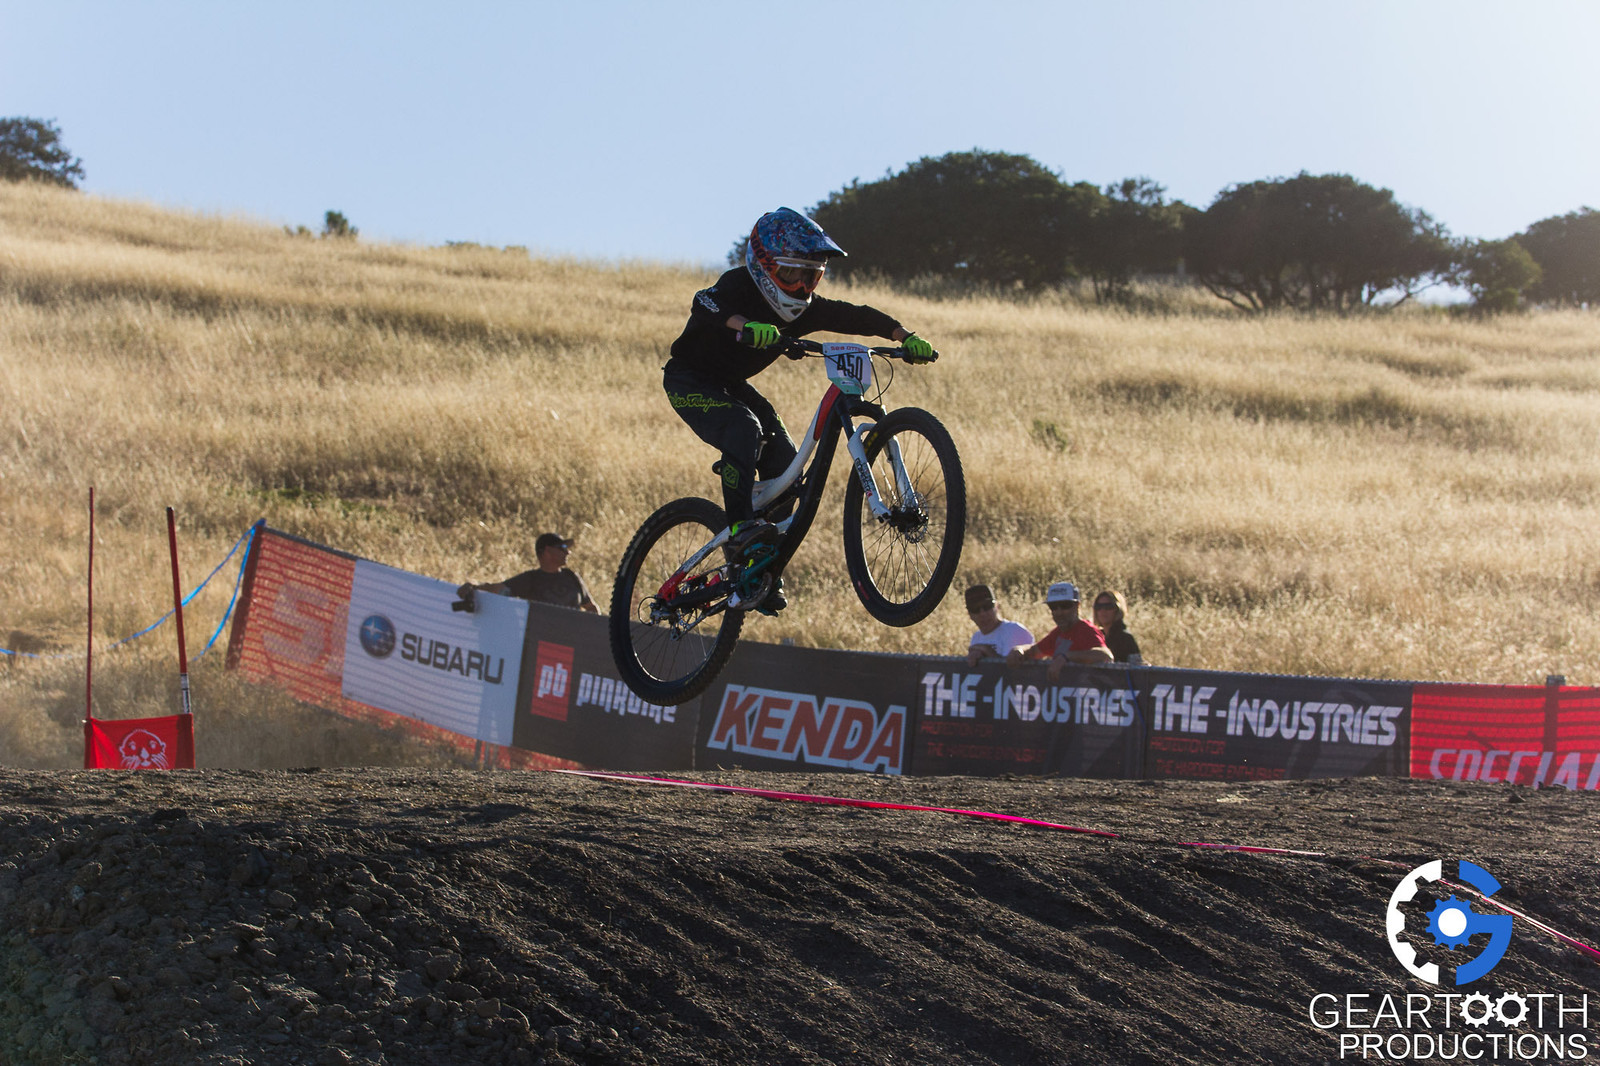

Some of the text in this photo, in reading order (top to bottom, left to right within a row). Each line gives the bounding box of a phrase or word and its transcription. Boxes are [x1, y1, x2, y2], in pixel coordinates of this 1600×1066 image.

[837, 354, 863, 381] 450
[401, 632, 505, 685] SUBARU
[707, 684, 907, 775] KENDA
